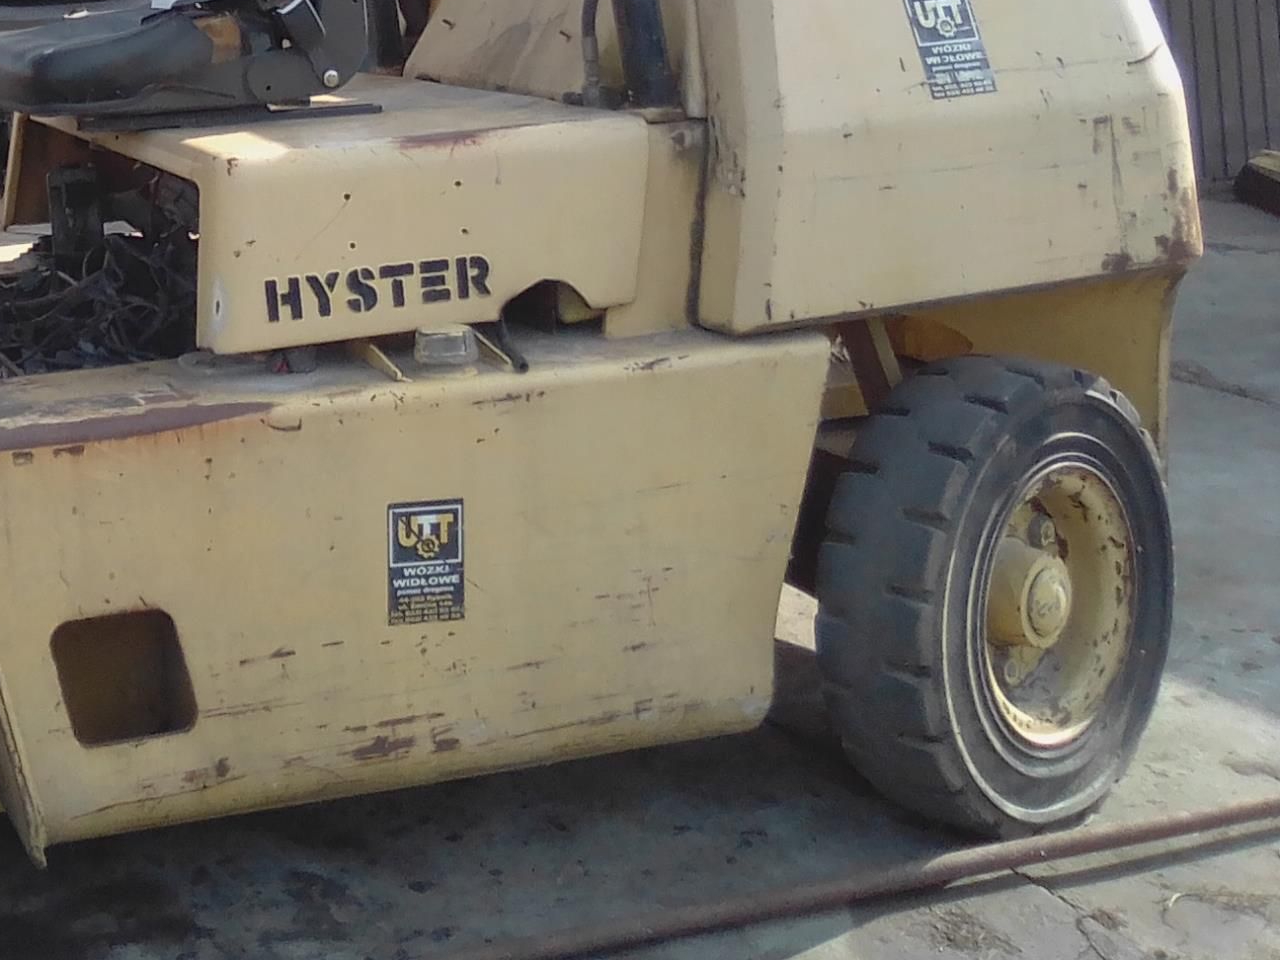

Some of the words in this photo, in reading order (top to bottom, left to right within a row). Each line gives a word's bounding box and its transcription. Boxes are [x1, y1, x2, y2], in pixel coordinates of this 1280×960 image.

[264, 255, 491, 322] HYSTER
[397, 513, 454, 548] UTT
[392, 574, 460, 588] WIDŁOWE
